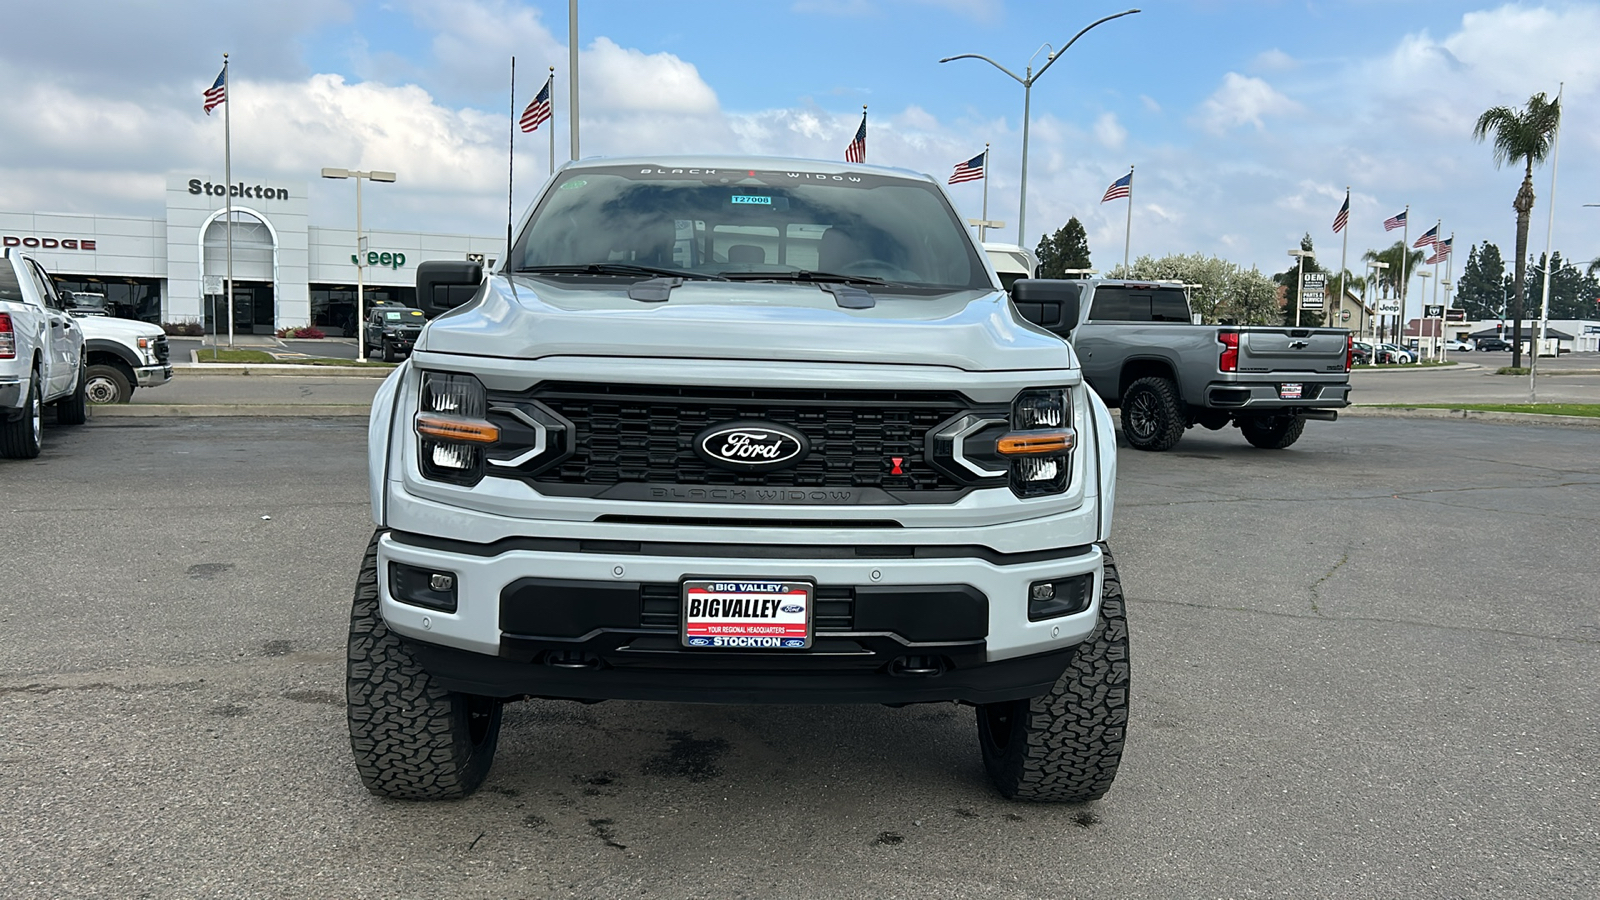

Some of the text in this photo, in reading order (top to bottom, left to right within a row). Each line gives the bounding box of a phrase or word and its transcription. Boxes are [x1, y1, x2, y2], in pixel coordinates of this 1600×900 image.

[786, 172, 861, 183] WIDOW
[188, 178, 289, 200] Stockton
[733, 196, 770, 204] T27008
[3, 236, 96, 251] DODGE
[1304, 273, 1325, 281] OEM
[1379, 304, 1399, 312] Jeep
[720, 432, 783, 458] Ford
[652, 487, 851, 502] BLACK WIDOW
[715, 583, 782, 592] BIG VALLEY
[722, 626, 746, 634] REGIONAL
[746, 626, 785, 634] HEADQUARTERS
[713, 637, 781, 647] STOCKTON
